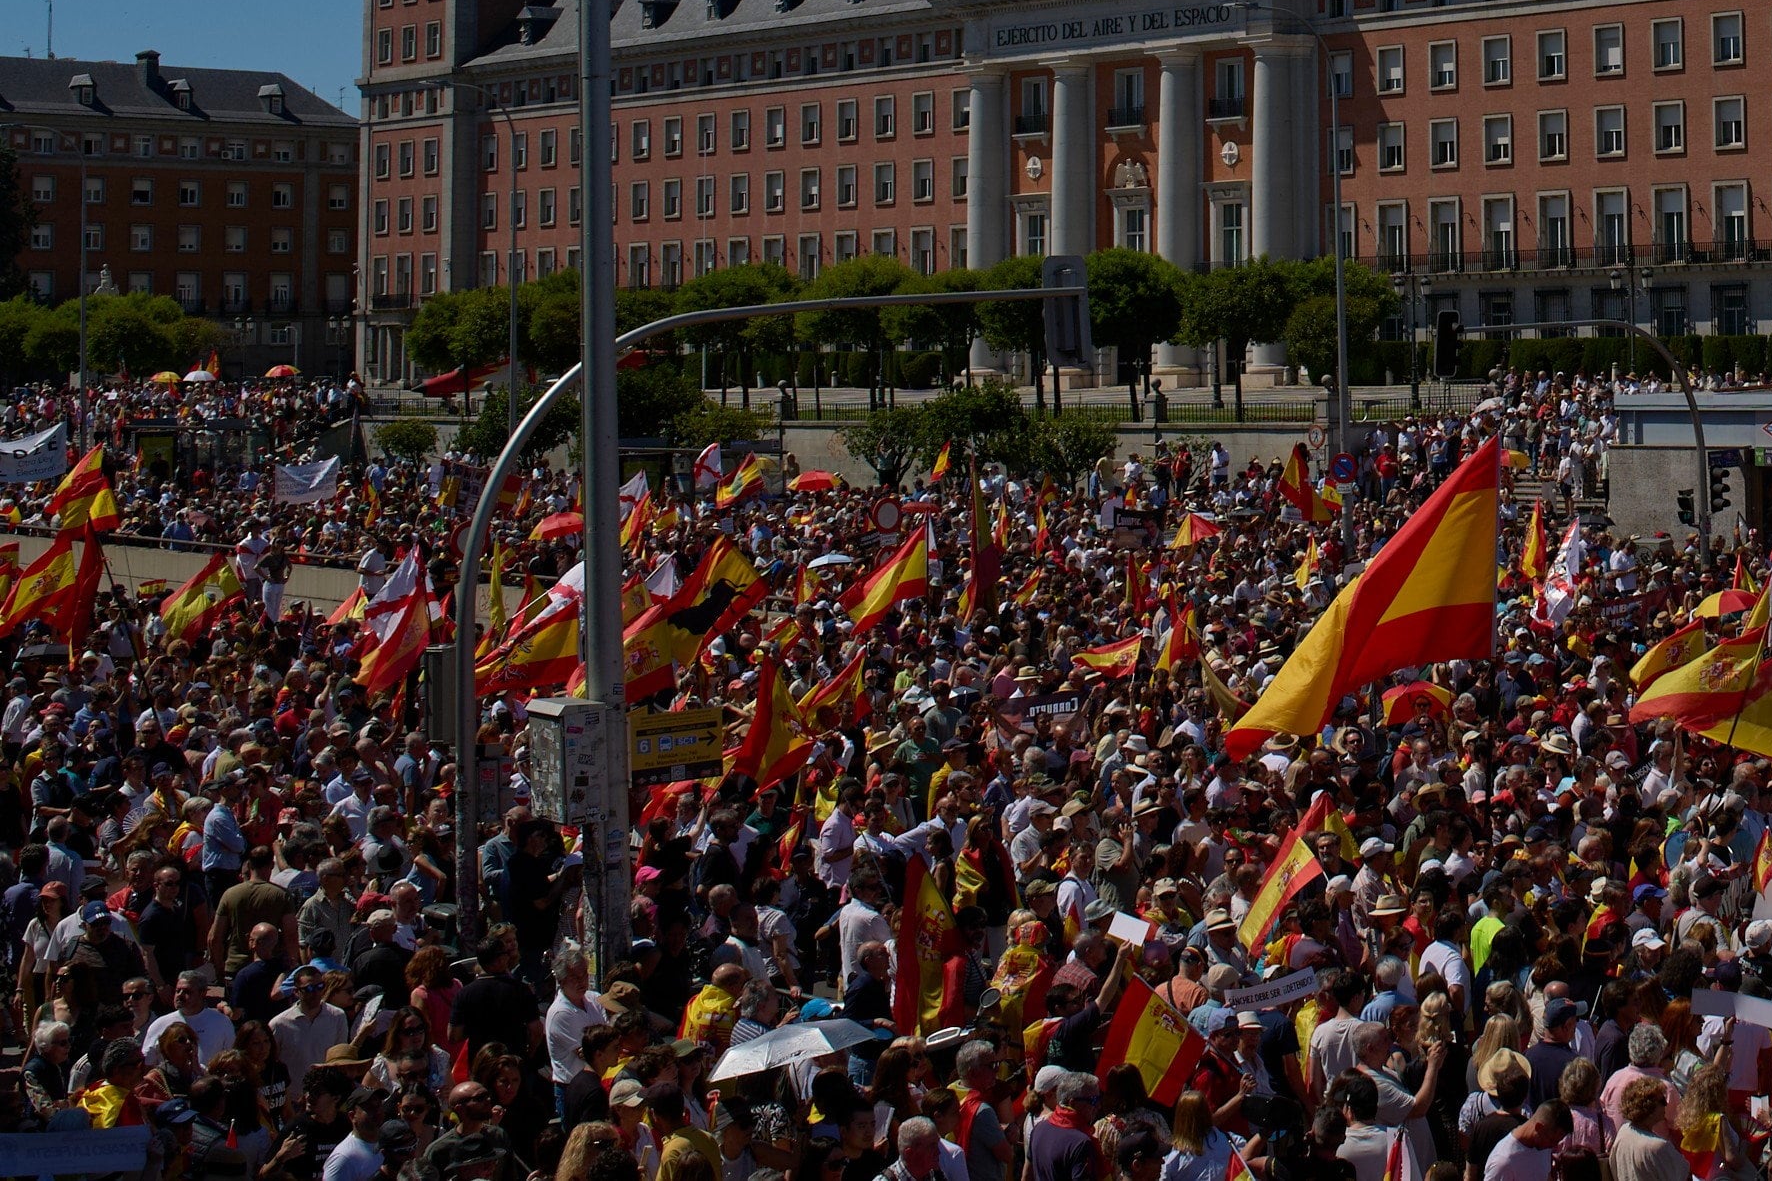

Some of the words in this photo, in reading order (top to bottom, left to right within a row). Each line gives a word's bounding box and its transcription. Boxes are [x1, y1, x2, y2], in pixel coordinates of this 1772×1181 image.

[997, 24, 1058, 47] EJÉRCITO
[1062, 21, 1088, 39] DEL
[1092, 17, 1123, 37] AIRE
[1129, 15, 1138, 32] Y
[1142, 12, 1169, 31] DEL
[1174, 5, 1230, 27] ESPACIO
[640, 739, 649, 751] 6
